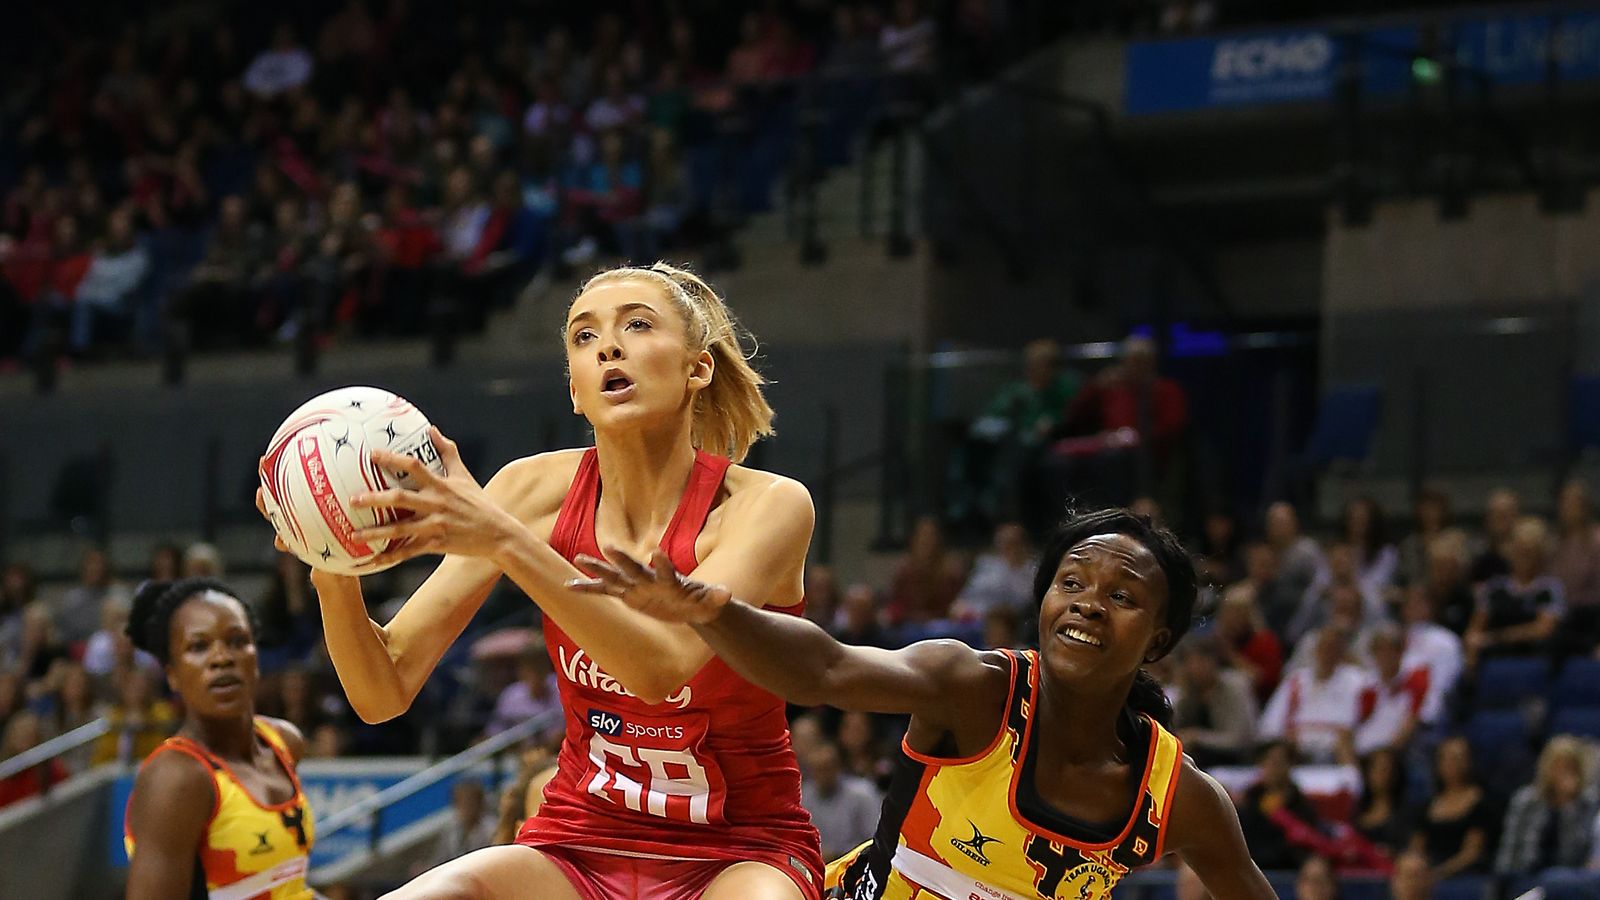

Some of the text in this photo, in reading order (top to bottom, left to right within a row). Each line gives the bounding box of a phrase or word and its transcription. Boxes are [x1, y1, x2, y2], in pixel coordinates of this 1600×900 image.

[559, 646, 692, 708] Vitay
[591, 713, 683, 739] sky sports
[588, 732, 709, 825] GA
[951, 838, 990, 867] GILBERT
[1064, 865, 1089, 883] TEAM
